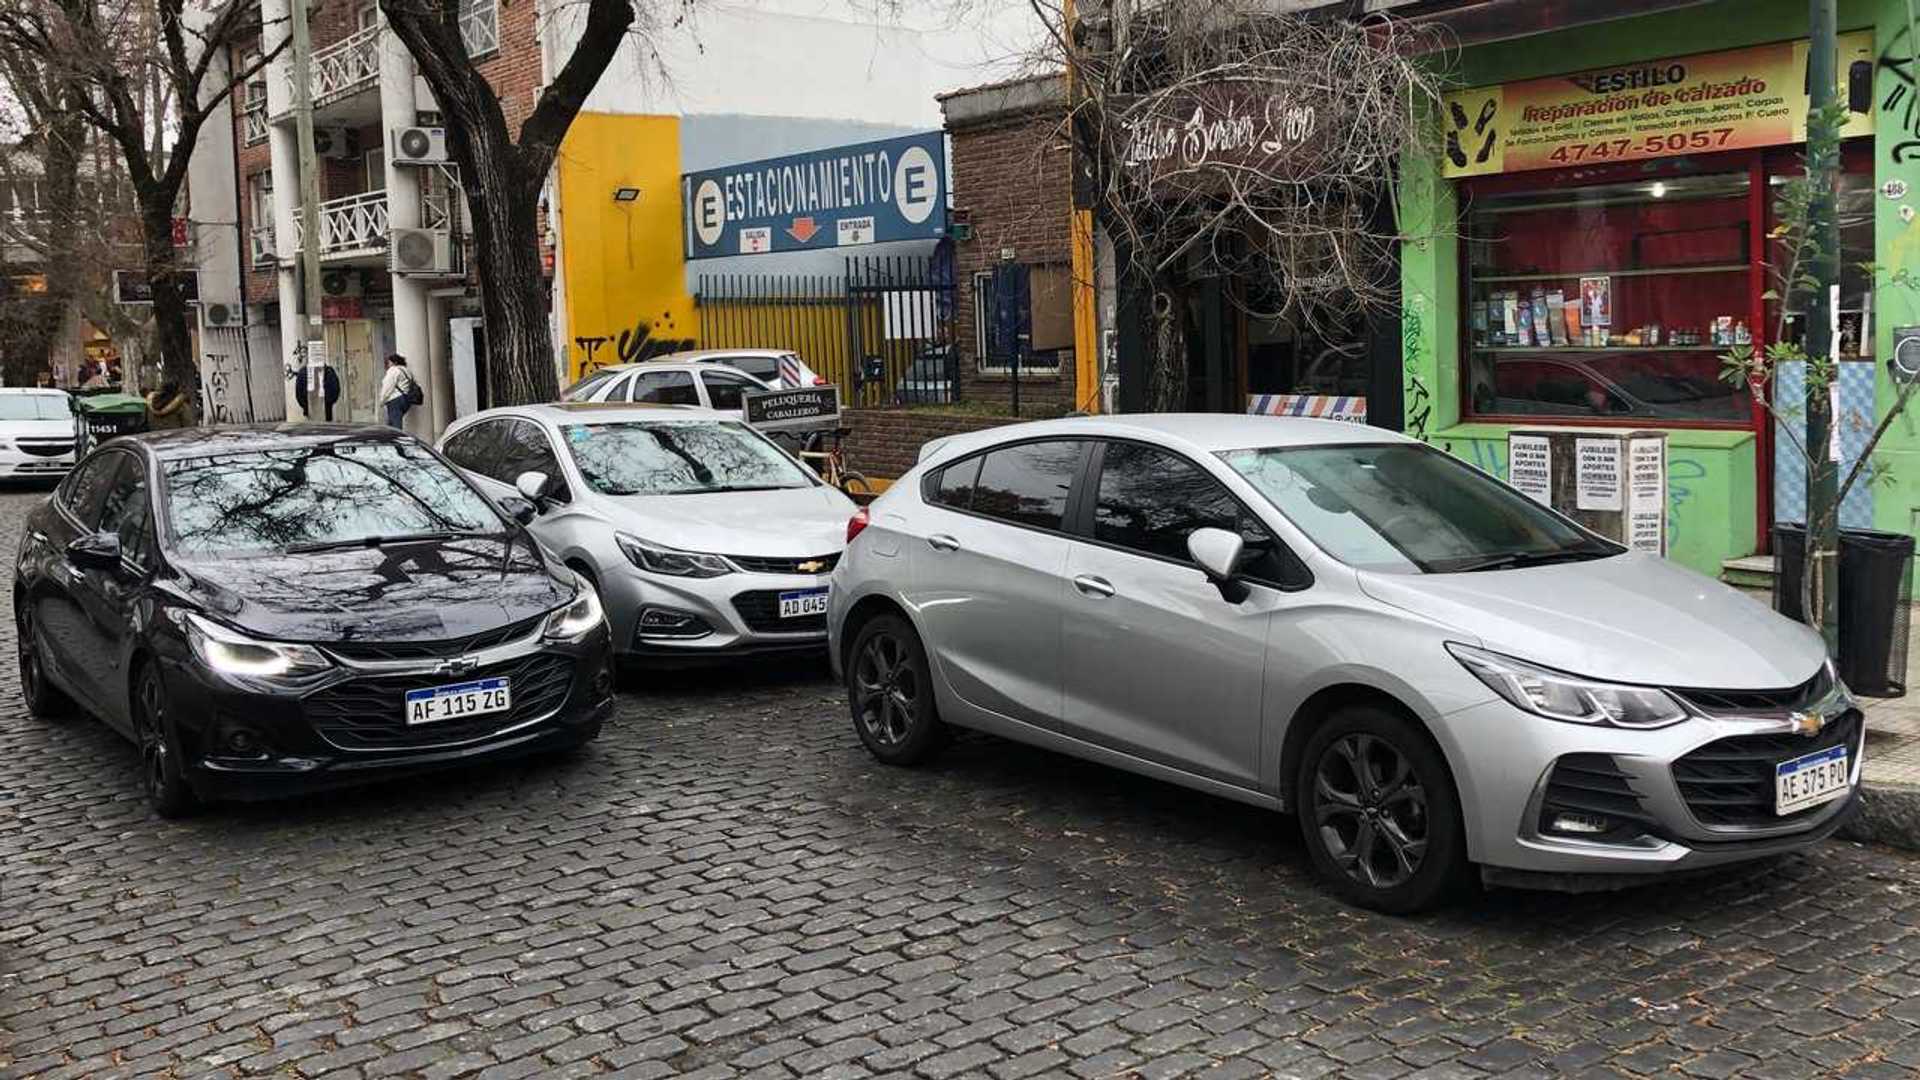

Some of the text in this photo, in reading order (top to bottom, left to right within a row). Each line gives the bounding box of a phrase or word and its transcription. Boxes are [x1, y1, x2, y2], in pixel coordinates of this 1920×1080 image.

[1595, 63, 1685, 94] ESTILO
[1643, 86, 1673, 108] de
[1674, 76, 1767, 103] calzado
[1694, 112, 1743, 125] Productos
[1756, 107, 1790, 118] Cuero
[1550, 127, 1735, 163] 4747-5057
[725, 150, 891, 222] ESTACIONAMIENTO
[904, 165, 926, 205] E
[702, 196, 717, 229] E
[840, 219, 873, 231] ENTRADA
[766, 406, 820, 420] CABALLEROS
[784, 597, 826, 615] AD 045
[413, 689, 505, 720] AF 115 ZG
[1782, 775, 1798, 801] AE
[1801, 766, 1826, 795] 375
